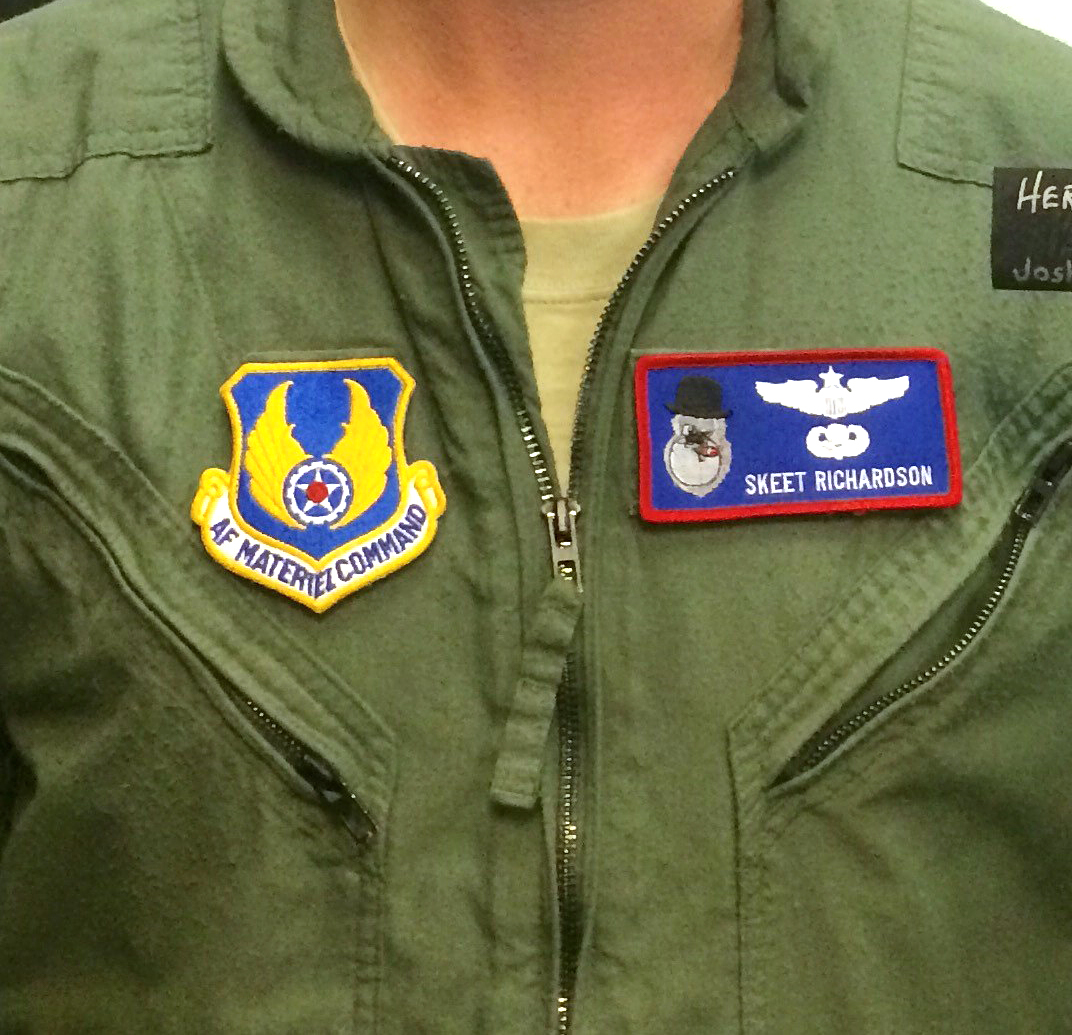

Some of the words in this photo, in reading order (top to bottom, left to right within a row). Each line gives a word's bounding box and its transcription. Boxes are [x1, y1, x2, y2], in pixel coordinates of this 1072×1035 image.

[744, 470, 807, 495] SKEET
[814, 464, 933, 492] RICHARDSON
[209, 517, 240, 547] AF
[234, 538, 337, 599] MATERIEL
[335, 503, 427, 583] COMMAND
